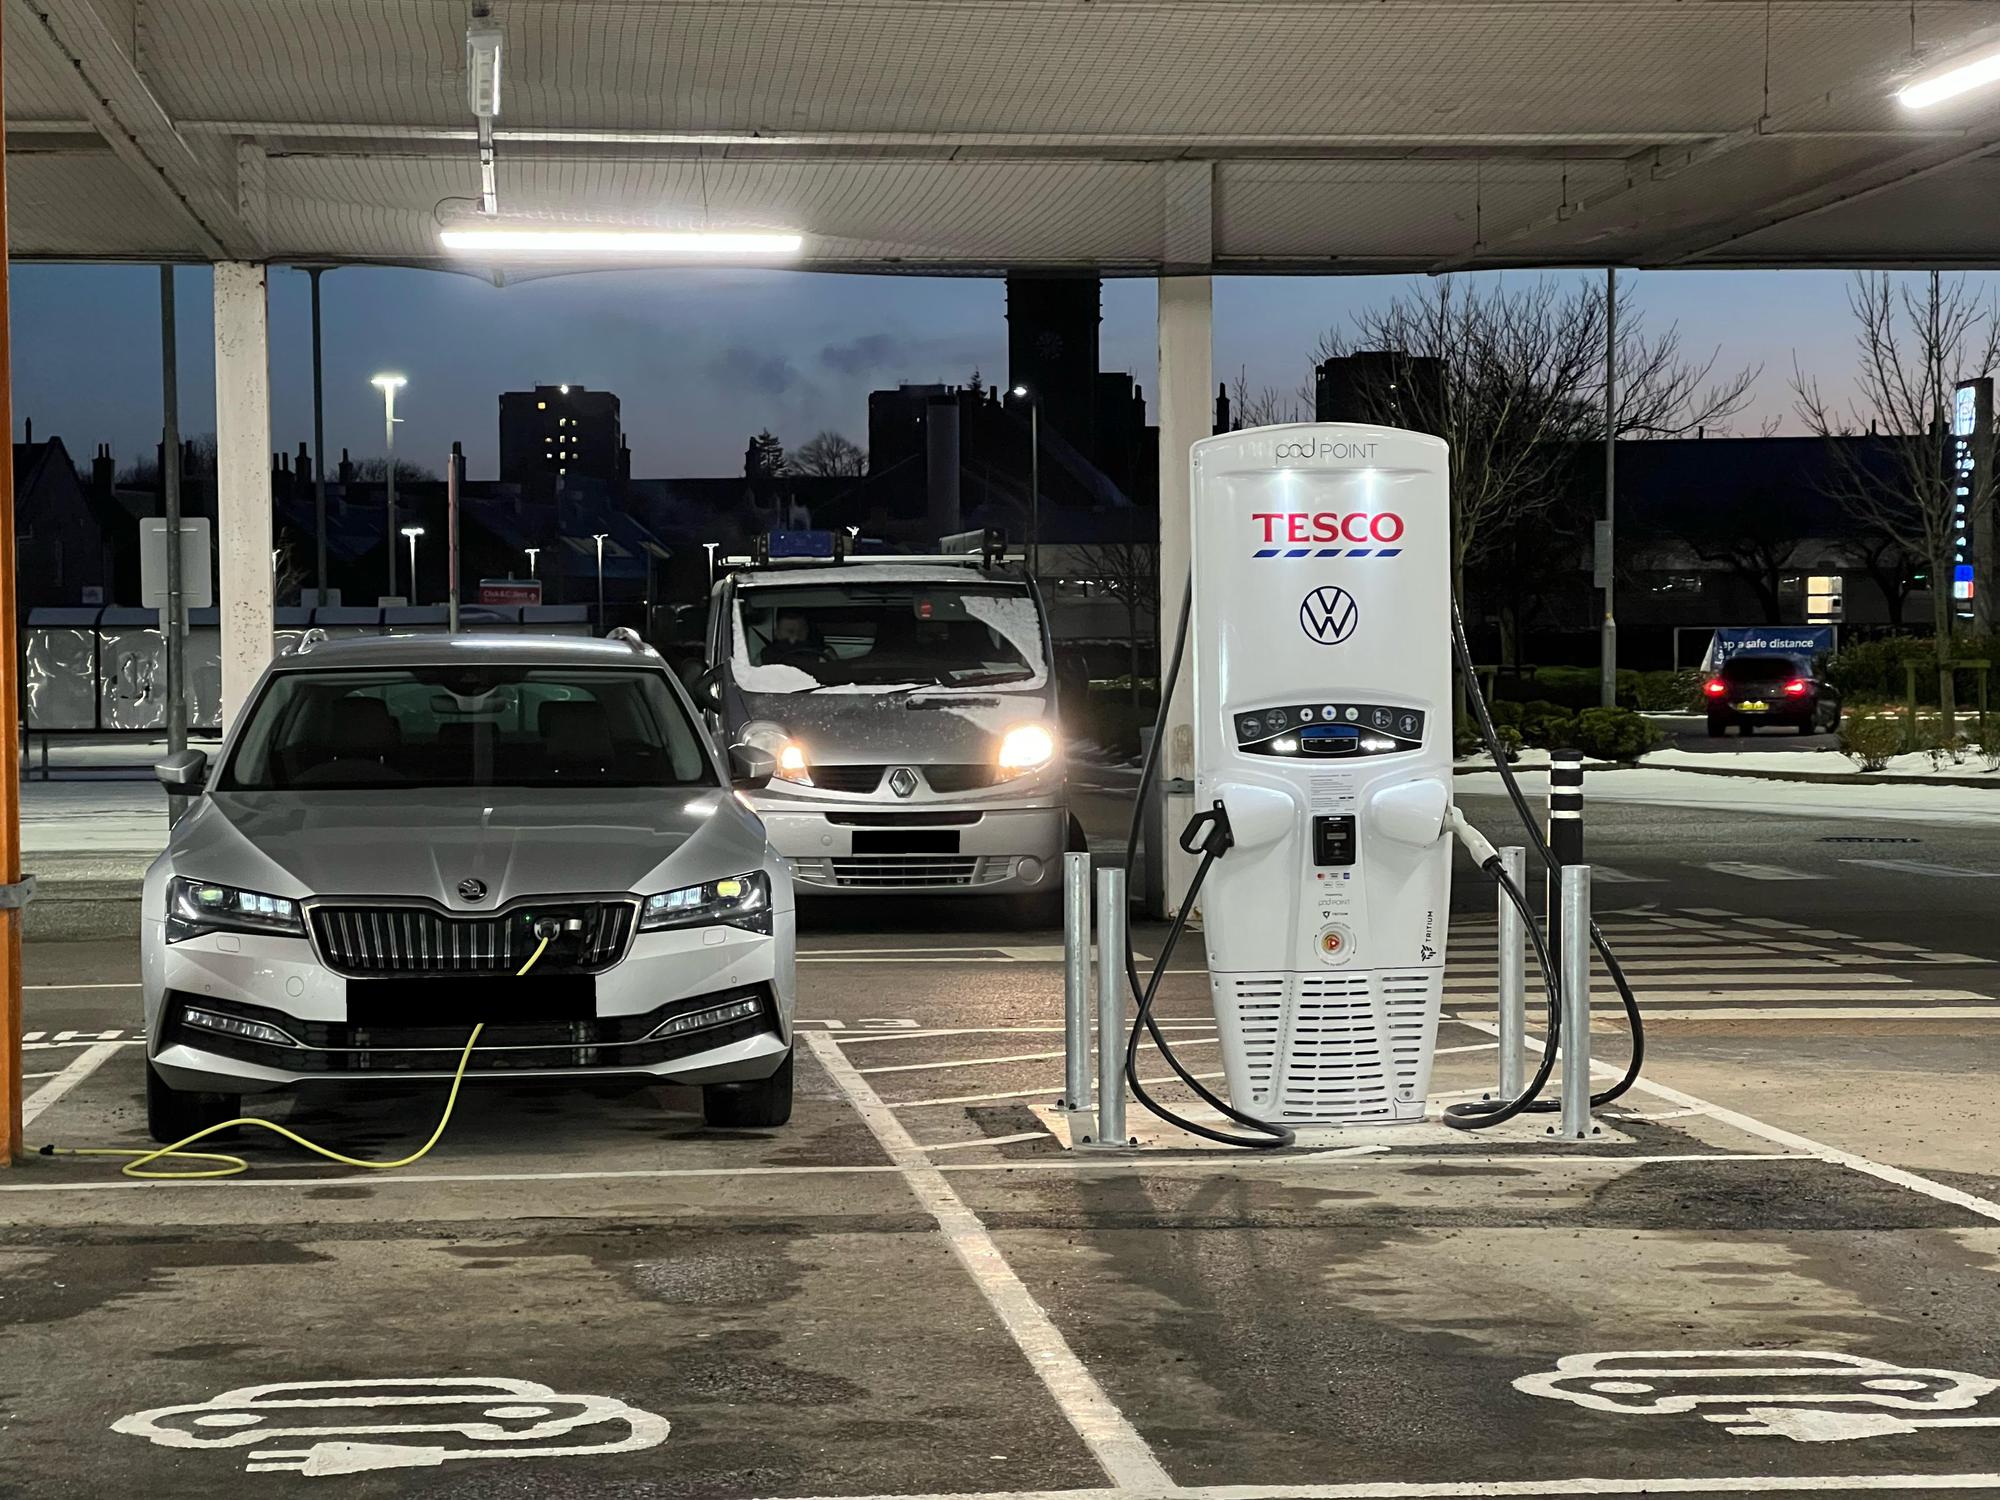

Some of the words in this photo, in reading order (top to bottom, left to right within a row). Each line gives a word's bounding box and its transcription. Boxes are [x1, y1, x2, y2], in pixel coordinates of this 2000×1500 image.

[1276, 437, 1315, 464] pod
[1320, 443, 1378, 459] POINT
[1252, 512, 1405, 543] TESCO
[1745, 639, 1767, 649] safe
[1769, 638, 1814, 649] distance
